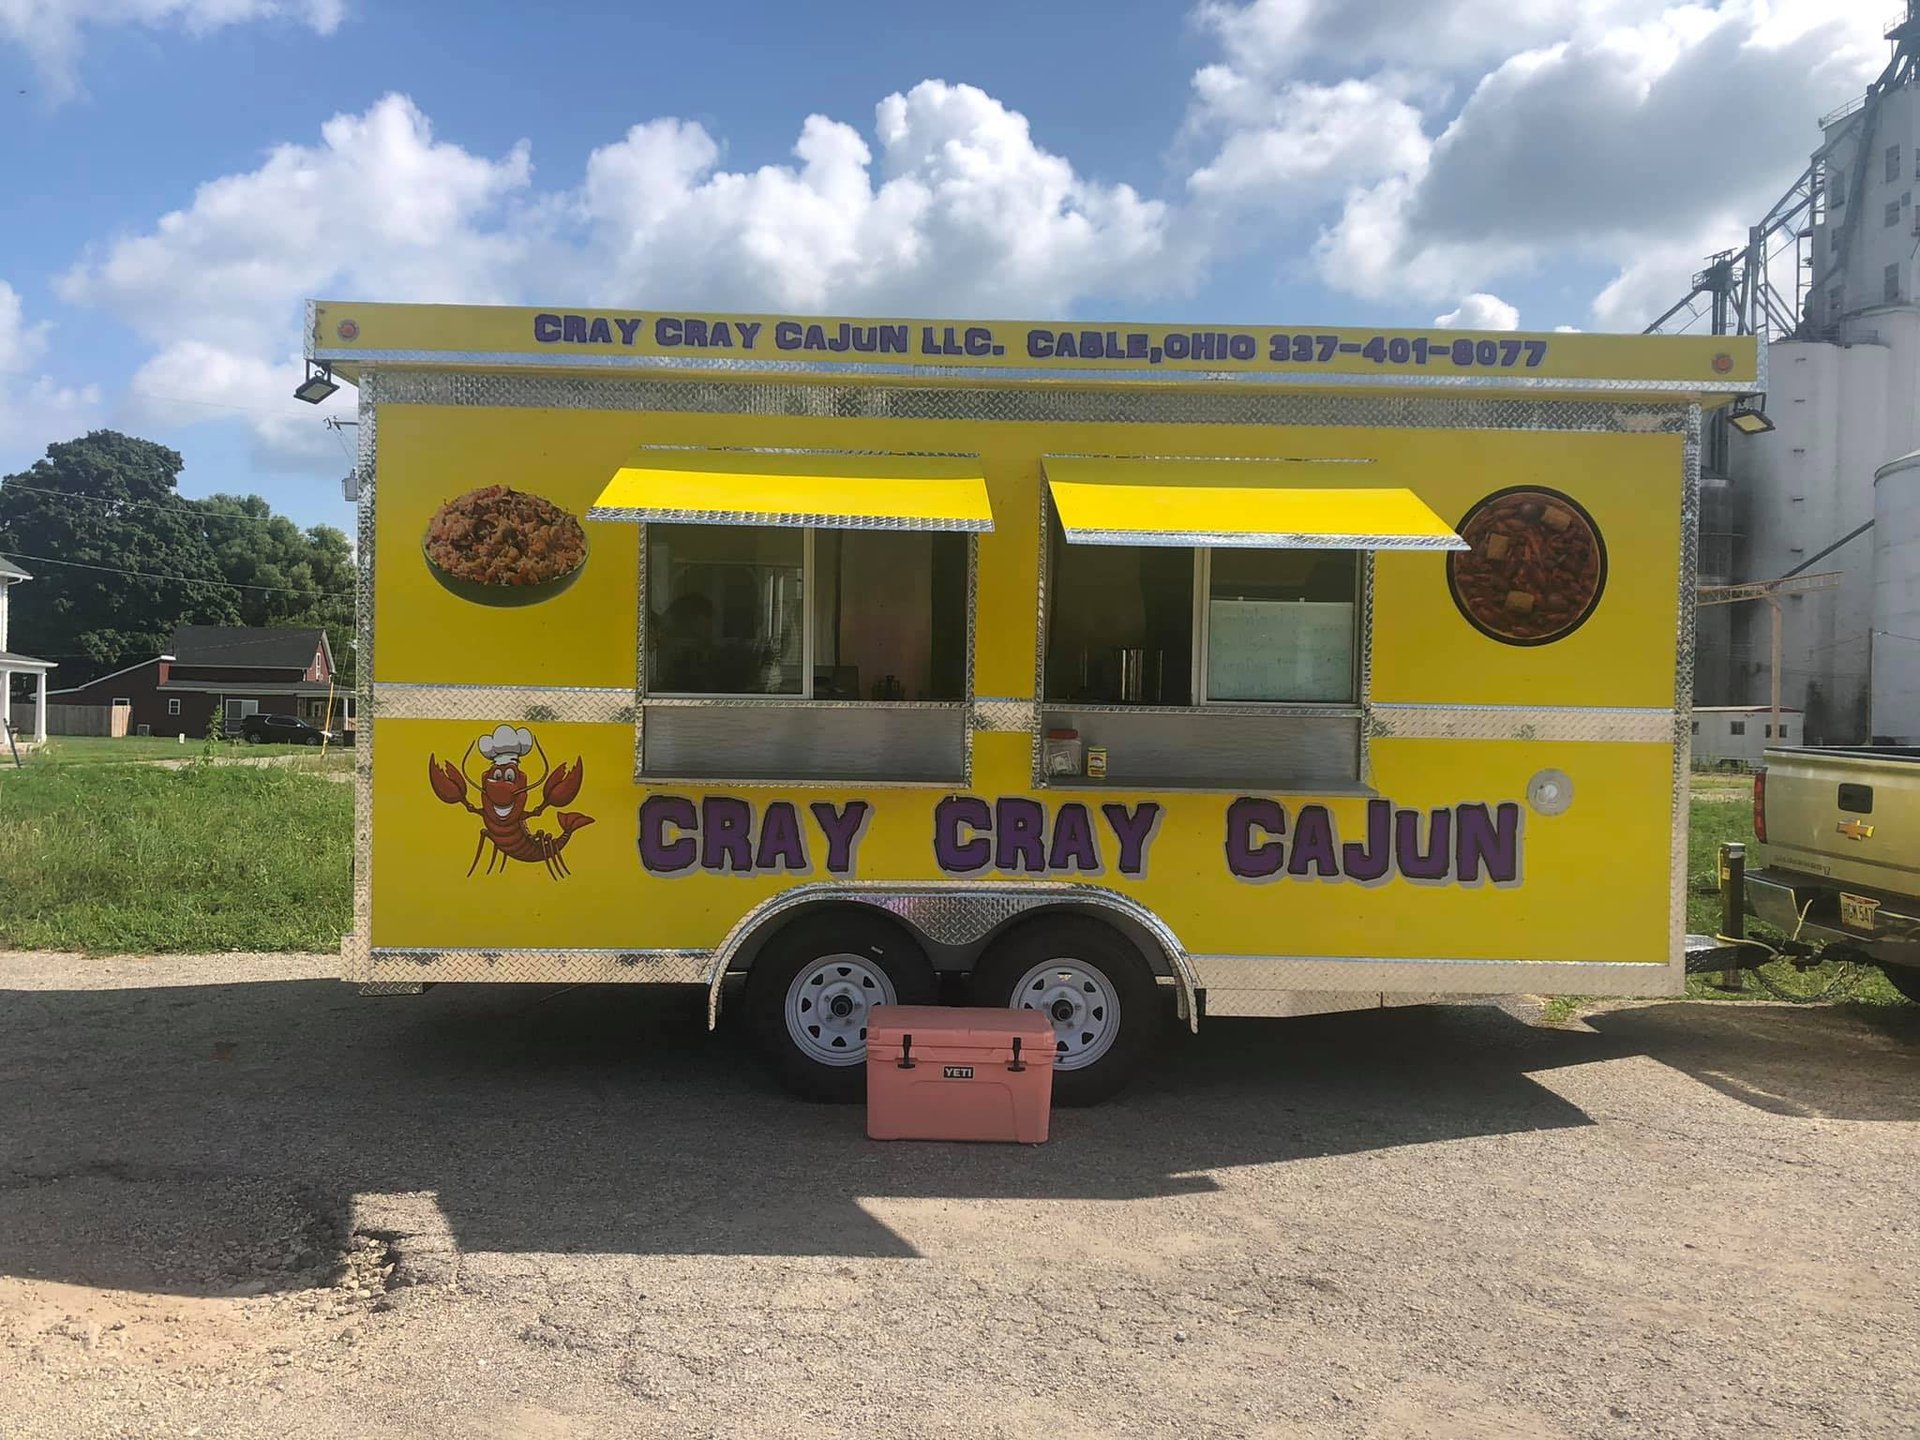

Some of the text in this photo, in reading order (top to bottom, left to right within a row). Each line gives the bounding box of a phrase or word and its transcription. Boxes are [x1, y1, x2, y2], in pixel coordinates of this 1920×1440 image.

[533, 313, 642, 346] CRAY
[655, 317, 763, 350] CRAY
[774, 320, 910, 354] CAJUN
[921, 326, 1005, 357] LLC.
[1269, 334, 1548, 368] 337-401-8077
[638, 794, 1522, 886] CRAY CRAY CAJUN
[945, 1068, 972, 1077] YETI
